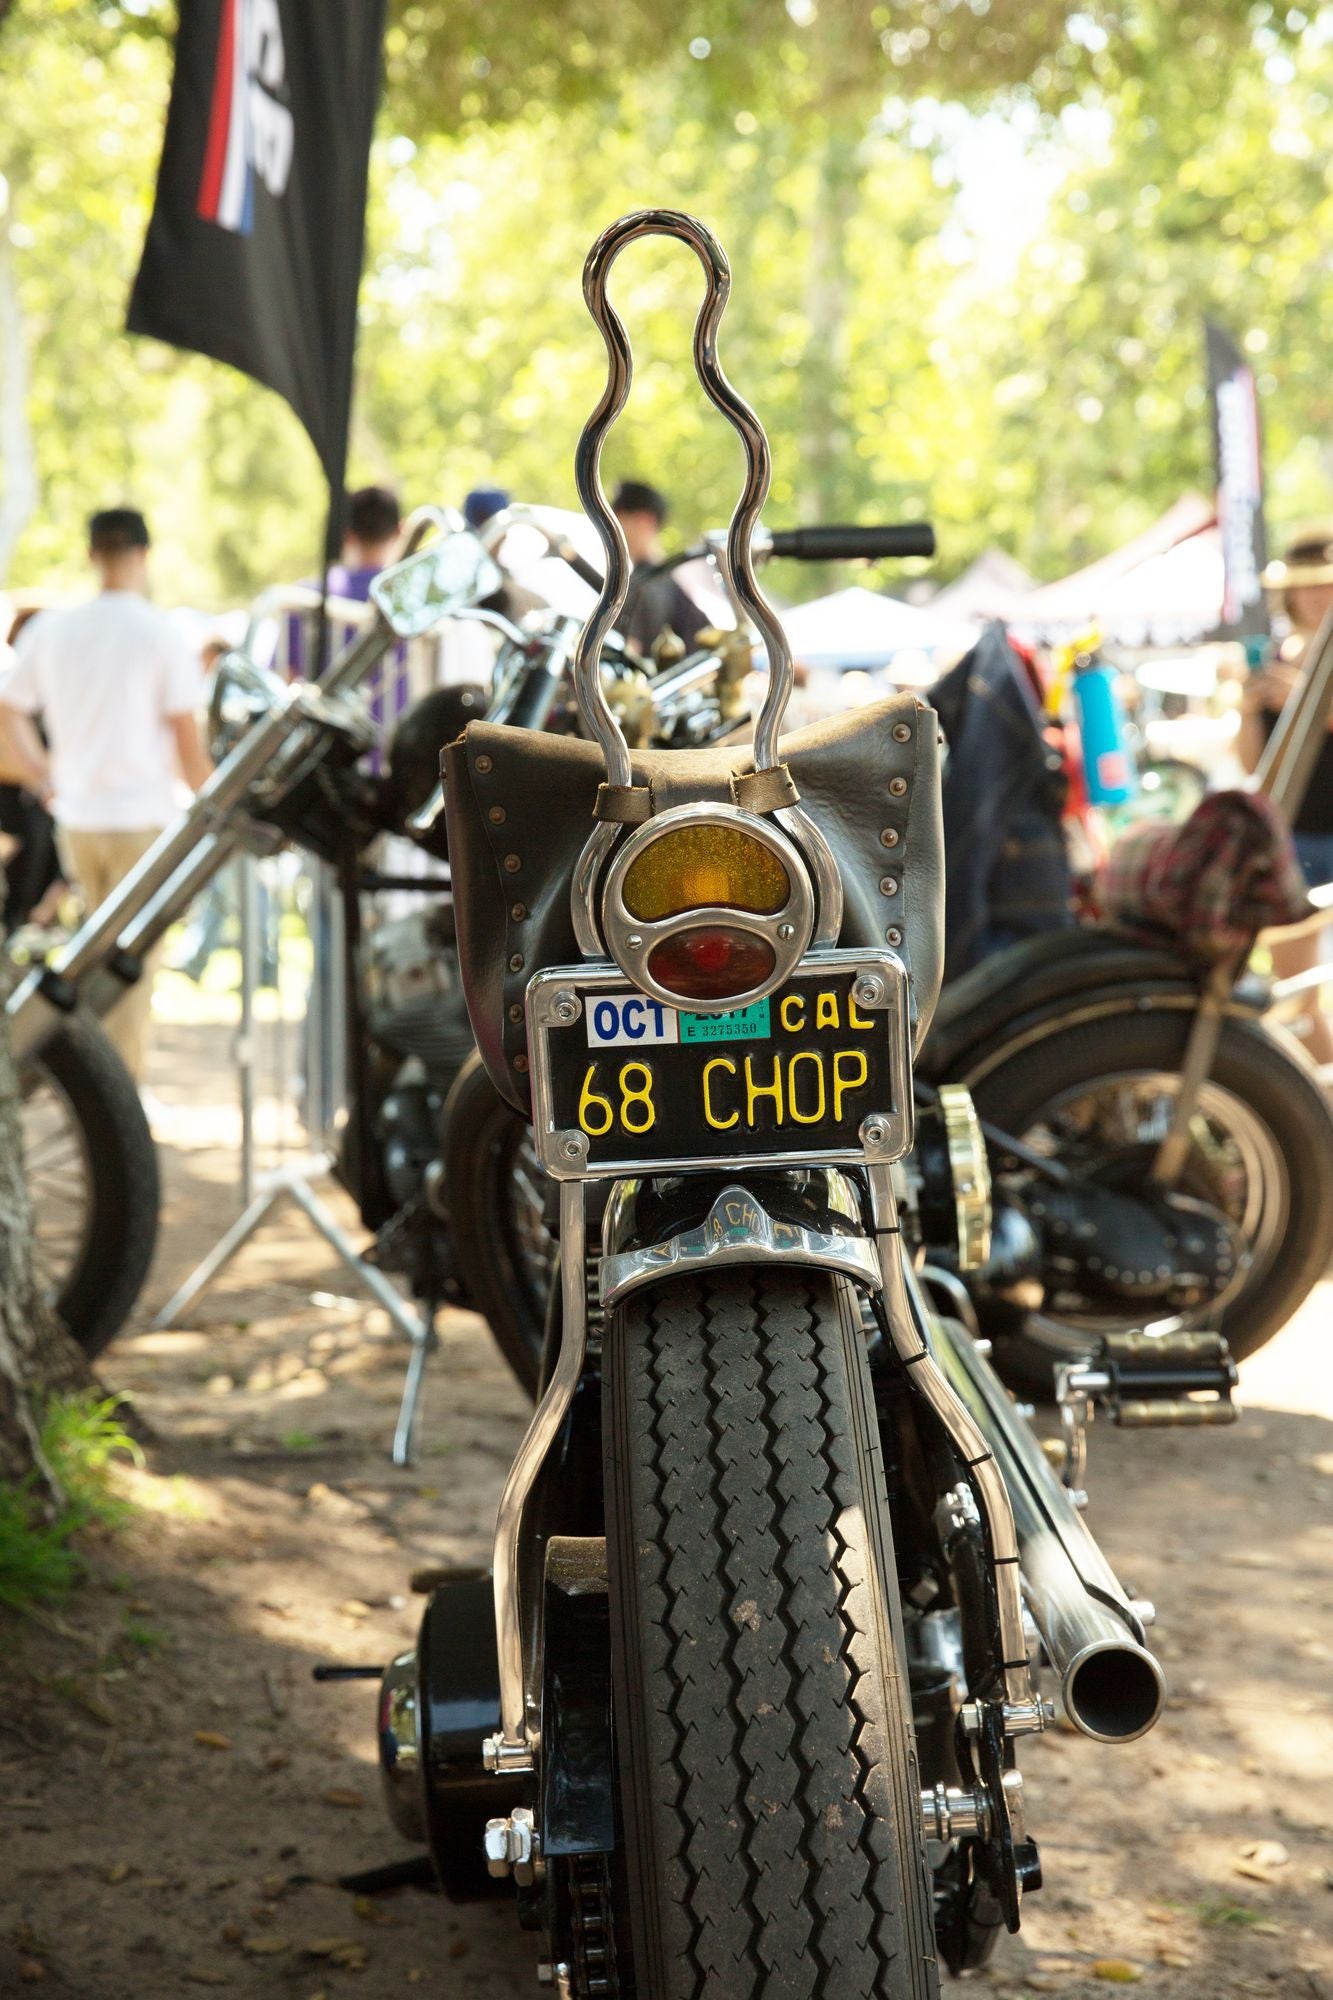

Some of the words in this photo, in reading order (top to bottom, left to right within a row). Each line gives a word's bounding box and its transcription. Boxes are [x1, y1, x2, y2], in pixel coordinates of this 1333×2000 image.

[594, 1000, 668, 1040] OCT
[687, 1026, 696, 1037] E
[702, 1022, 757, 1036] 3275350
[780, 993, 874, 1031] CAL
[578, 1063, 656, 1136] 68
[703, 1050, 868, 1129] CHOP
